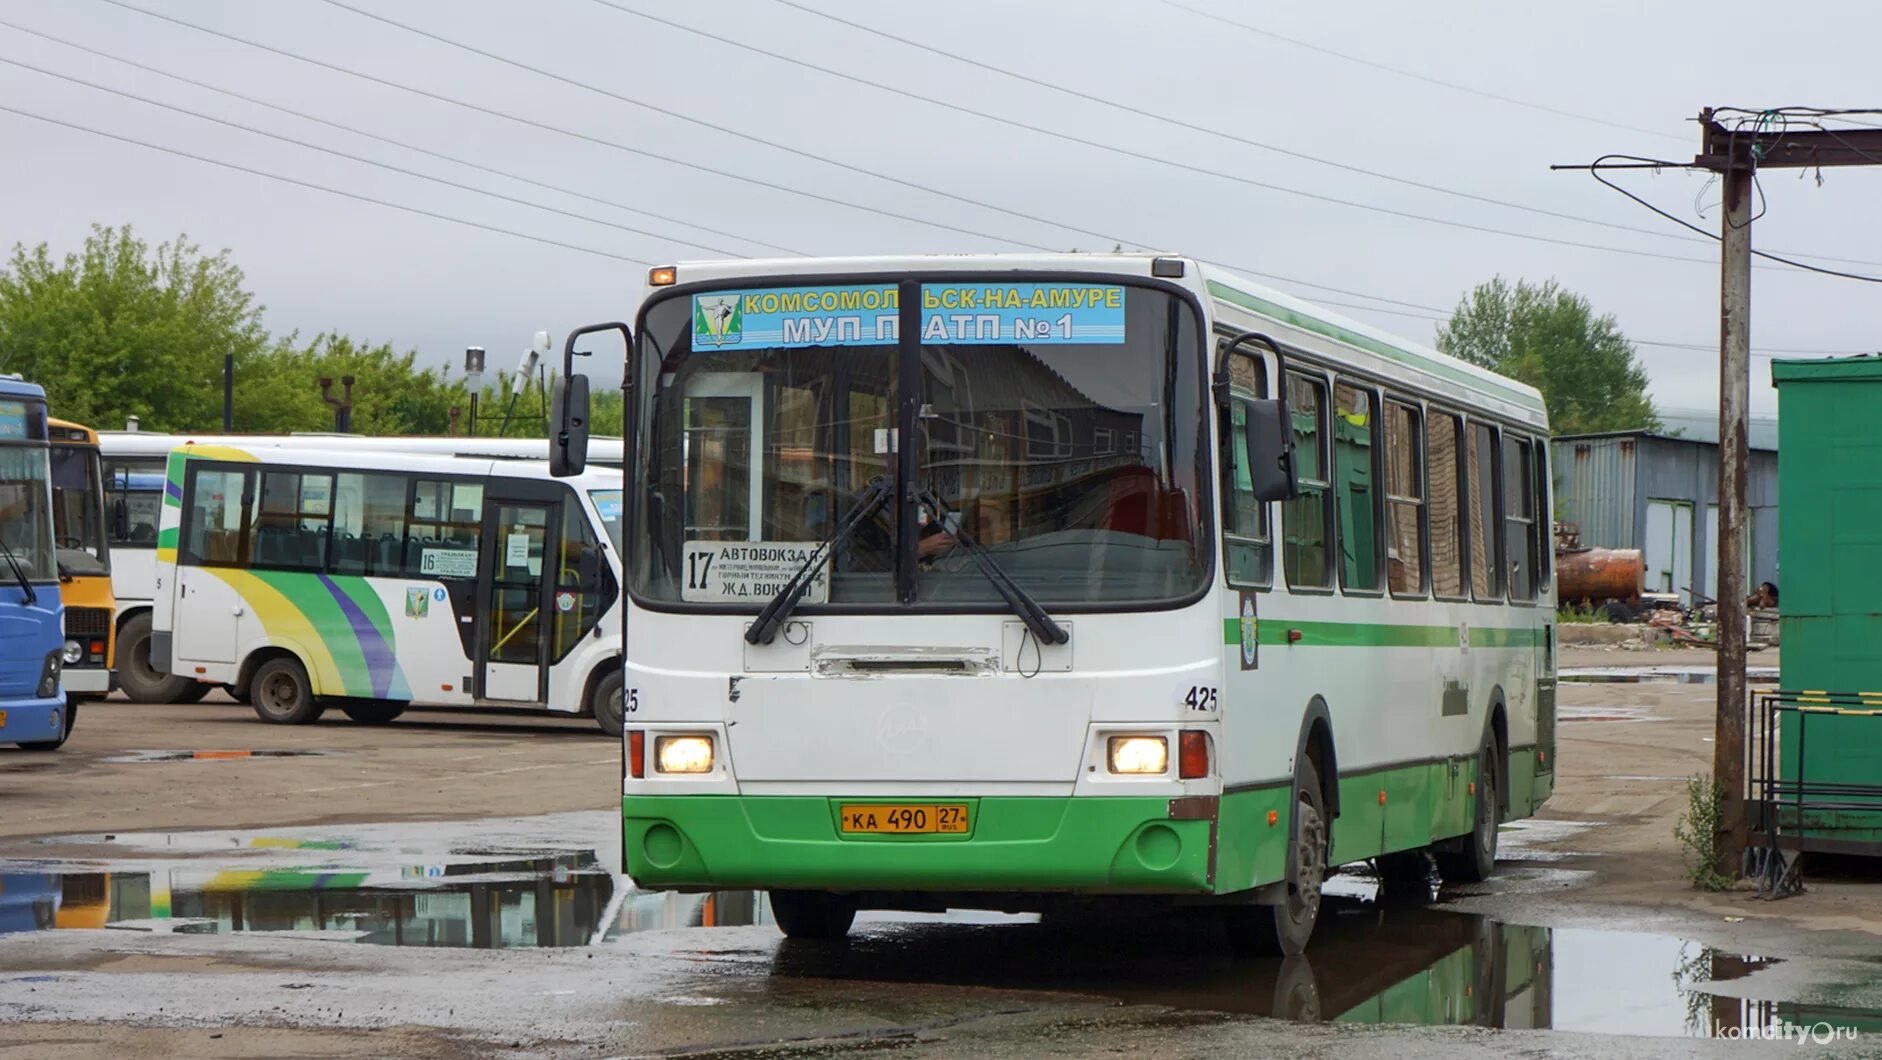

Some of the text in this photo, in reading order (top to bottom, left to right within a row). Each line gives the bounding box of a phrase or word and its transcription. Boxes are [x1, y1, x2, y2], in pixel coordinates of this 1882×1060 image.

[782, 316, 862, 344] МУП
[423, 553, 435, 571] 16
[688, 551, 715, 589] 17
[1184, 685, 1218, 713] 425
[887, 808, 926, 830] 490
[939, 807, 960, 824] 27
